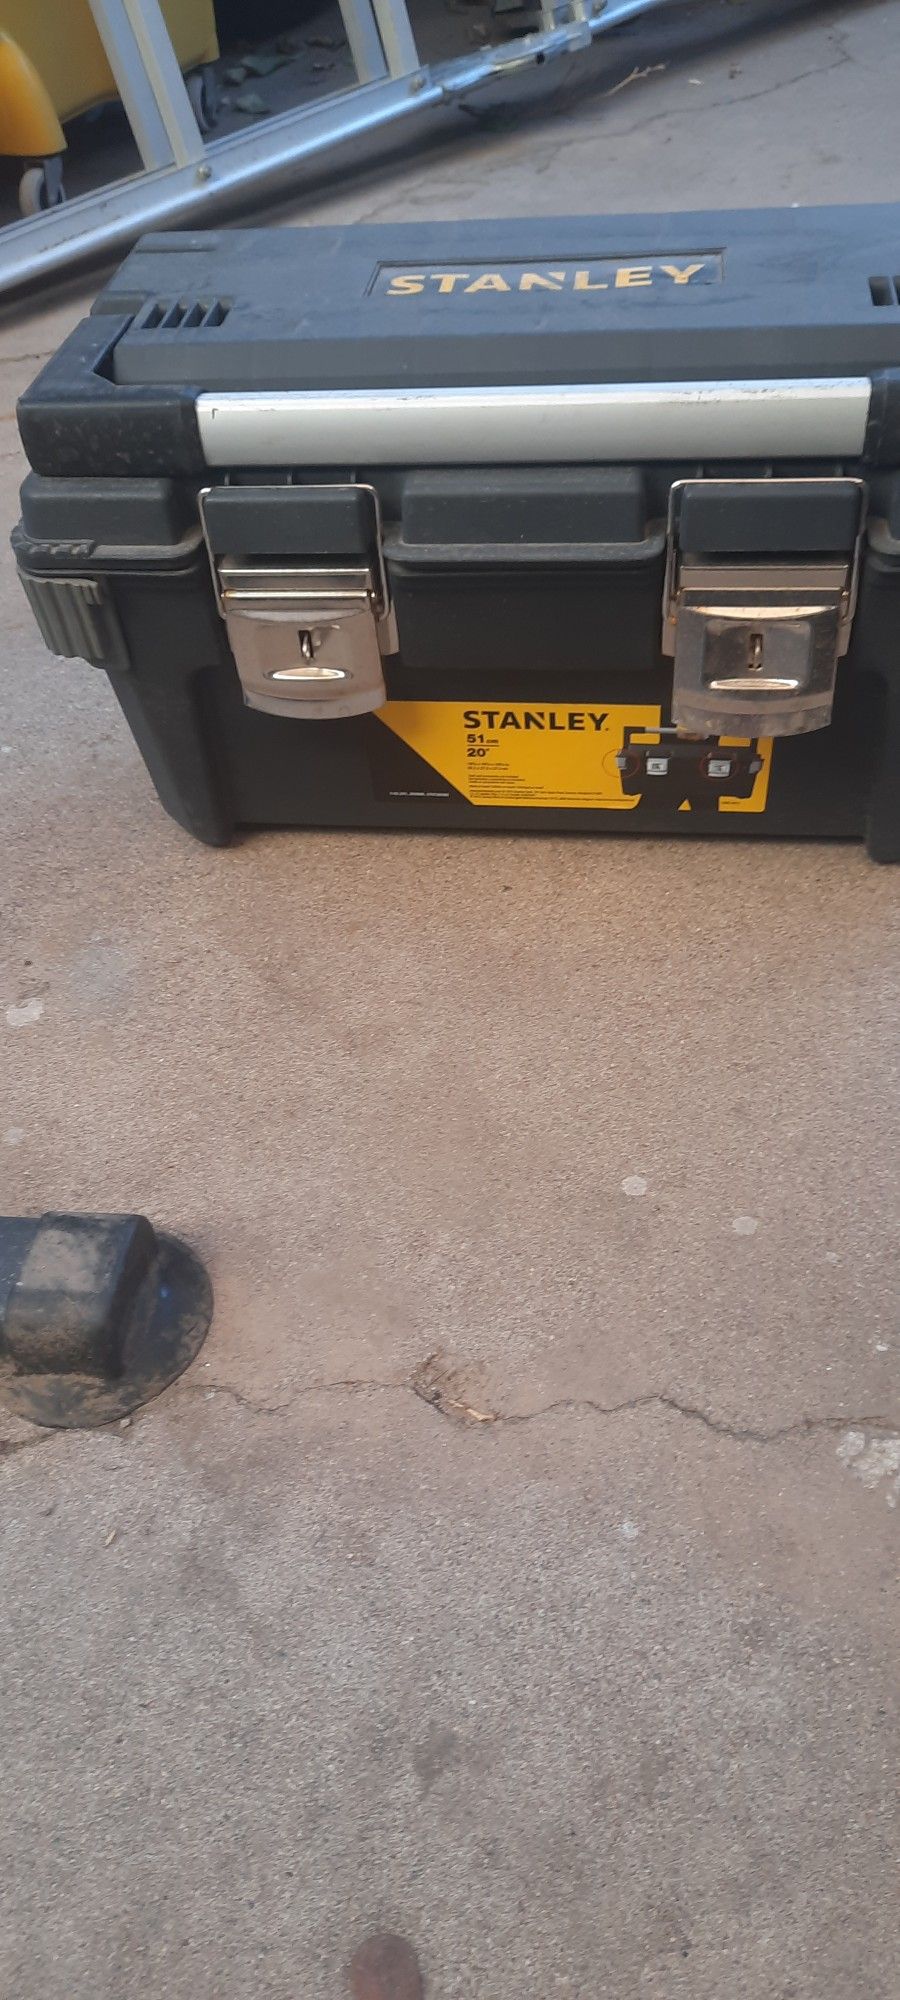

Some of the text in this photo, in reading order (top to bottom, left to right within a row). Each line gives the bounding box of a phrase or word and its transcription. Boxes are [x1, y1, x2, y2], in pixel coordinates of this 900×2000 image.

[386, 263, 706, 296] STANLEY
[463, 710, 609, 731] STANLEY
[466, 733, 485, 744] 51
